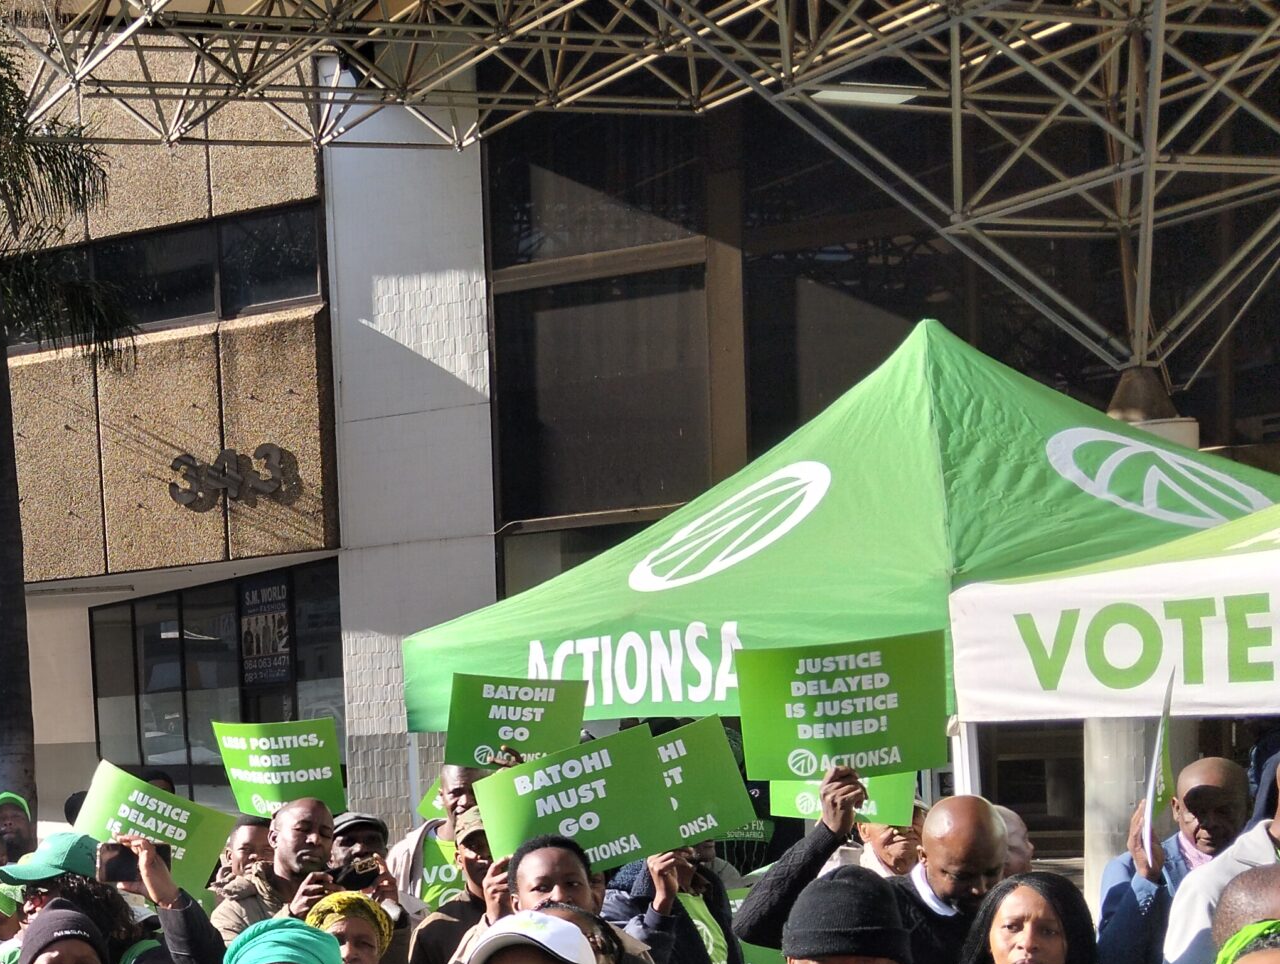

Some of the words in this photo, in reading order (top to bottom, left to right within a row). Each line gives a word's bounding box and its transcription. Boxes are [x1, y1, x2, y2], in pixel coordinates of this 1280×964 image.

[260, 585, 287, 603] WORLD
[1013, 592, 1275, 691] VOTE
[795, 651, 882, 675] JUSTICE
[482, 684, 556, 702] BATOHI
[791, 672, 890, 697] DELAYED
[489, 706, 545, 722] MUST
[785, 703, 807, 718] IS
[813, 693, 898, 718] JUSTICE
[497, 726, 530, 741] GO
[797, 715, 888, 739] DENIED!
[250, 733, 325, 750] POLITICS,
[248, 754, 291, 768] MORE
[820, 746, 902, 772] ACTIONSA
[230, 766, 333, 785] PROSECUTIONS
[513, 749, 613, 796] BATOHI
[128, 789, 191, 824] JUSTICE
[535, 778, 607, 818] MUST
[105, 817, 122, 834] IS
[117, 803, 187, 842] DELAYED
[558, 812, 600, 838] GO
[679, 813, 718, 838] ONSA
[751, 819, 765, 831] FIX
[584, 833, 642, 864] TIONSA
[423, 864, 467, 885] VO
[53, 929, 90, 938] NISSAN
